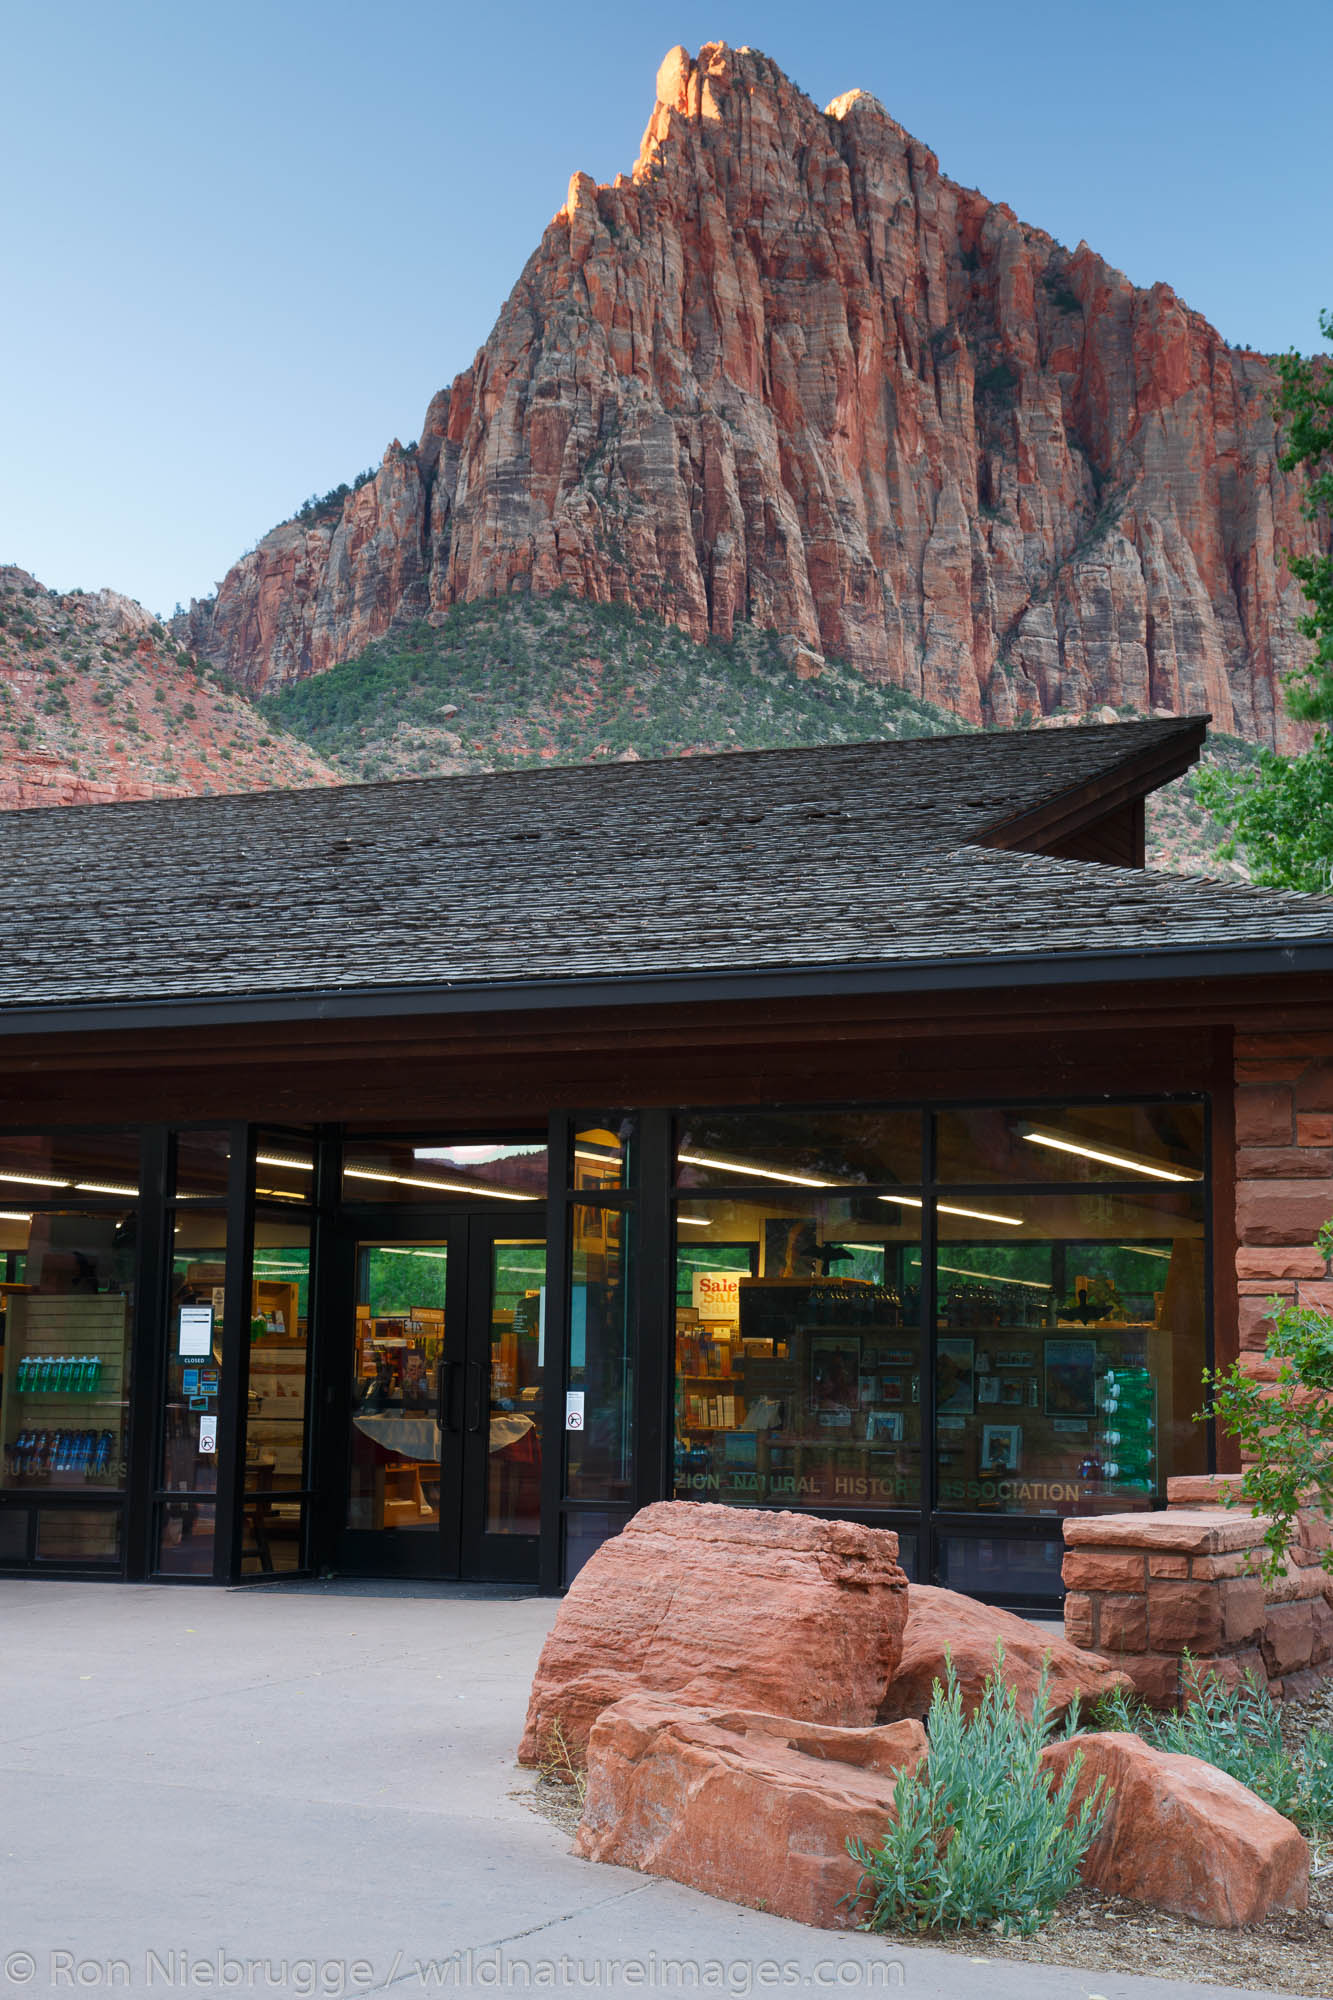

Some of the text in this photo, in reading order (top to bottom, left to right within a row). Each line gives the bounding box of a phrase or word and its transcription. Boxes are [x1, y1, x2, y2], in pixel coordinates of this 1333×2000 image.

[700, 1278, 737, 1293] Sale
[704, 1290, 739, 1303] Sale
[84, 1462, 128, 1478] MAPS
[672, 1473, 721, 1489] ZION
[735, 1474, 821, 1493] NATURAL
[937, 1479, 1080, 1502] ASSOCIATION
